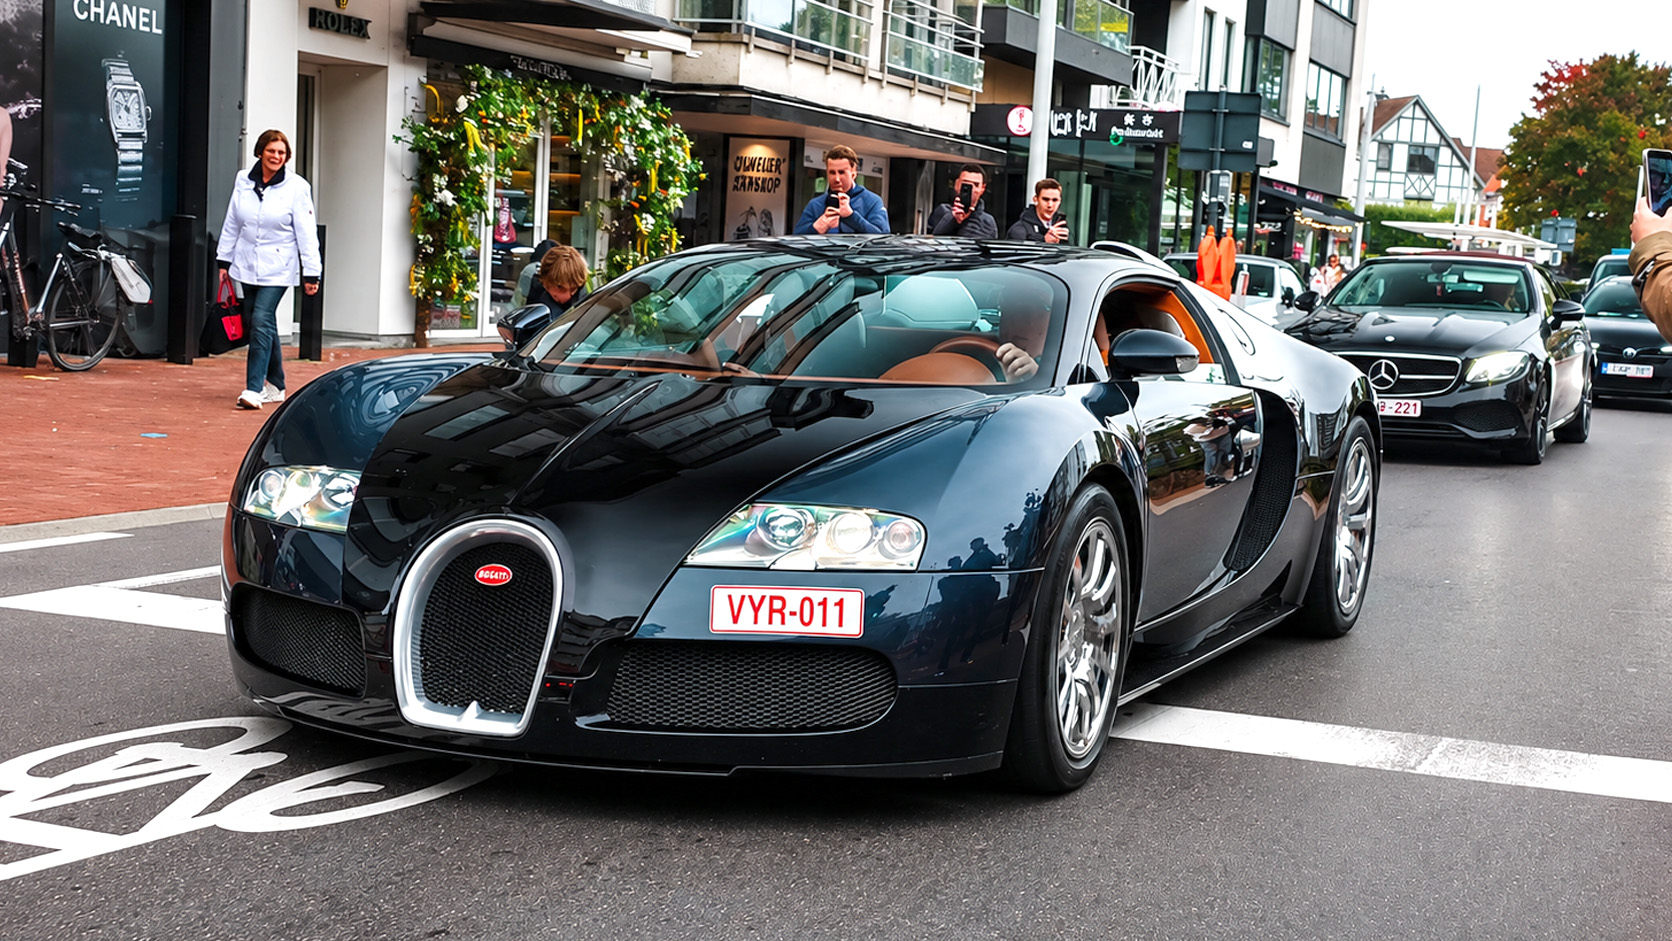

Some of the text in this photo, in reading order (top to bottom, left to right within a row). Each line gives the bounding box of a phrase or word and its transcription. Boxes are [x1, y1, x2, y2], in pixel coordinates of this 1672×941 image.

[73, 0, 163, 34] CHANEL
[315, 9, 368, 38] ROLEX
[727, 594, 844, 628] VYR-011
